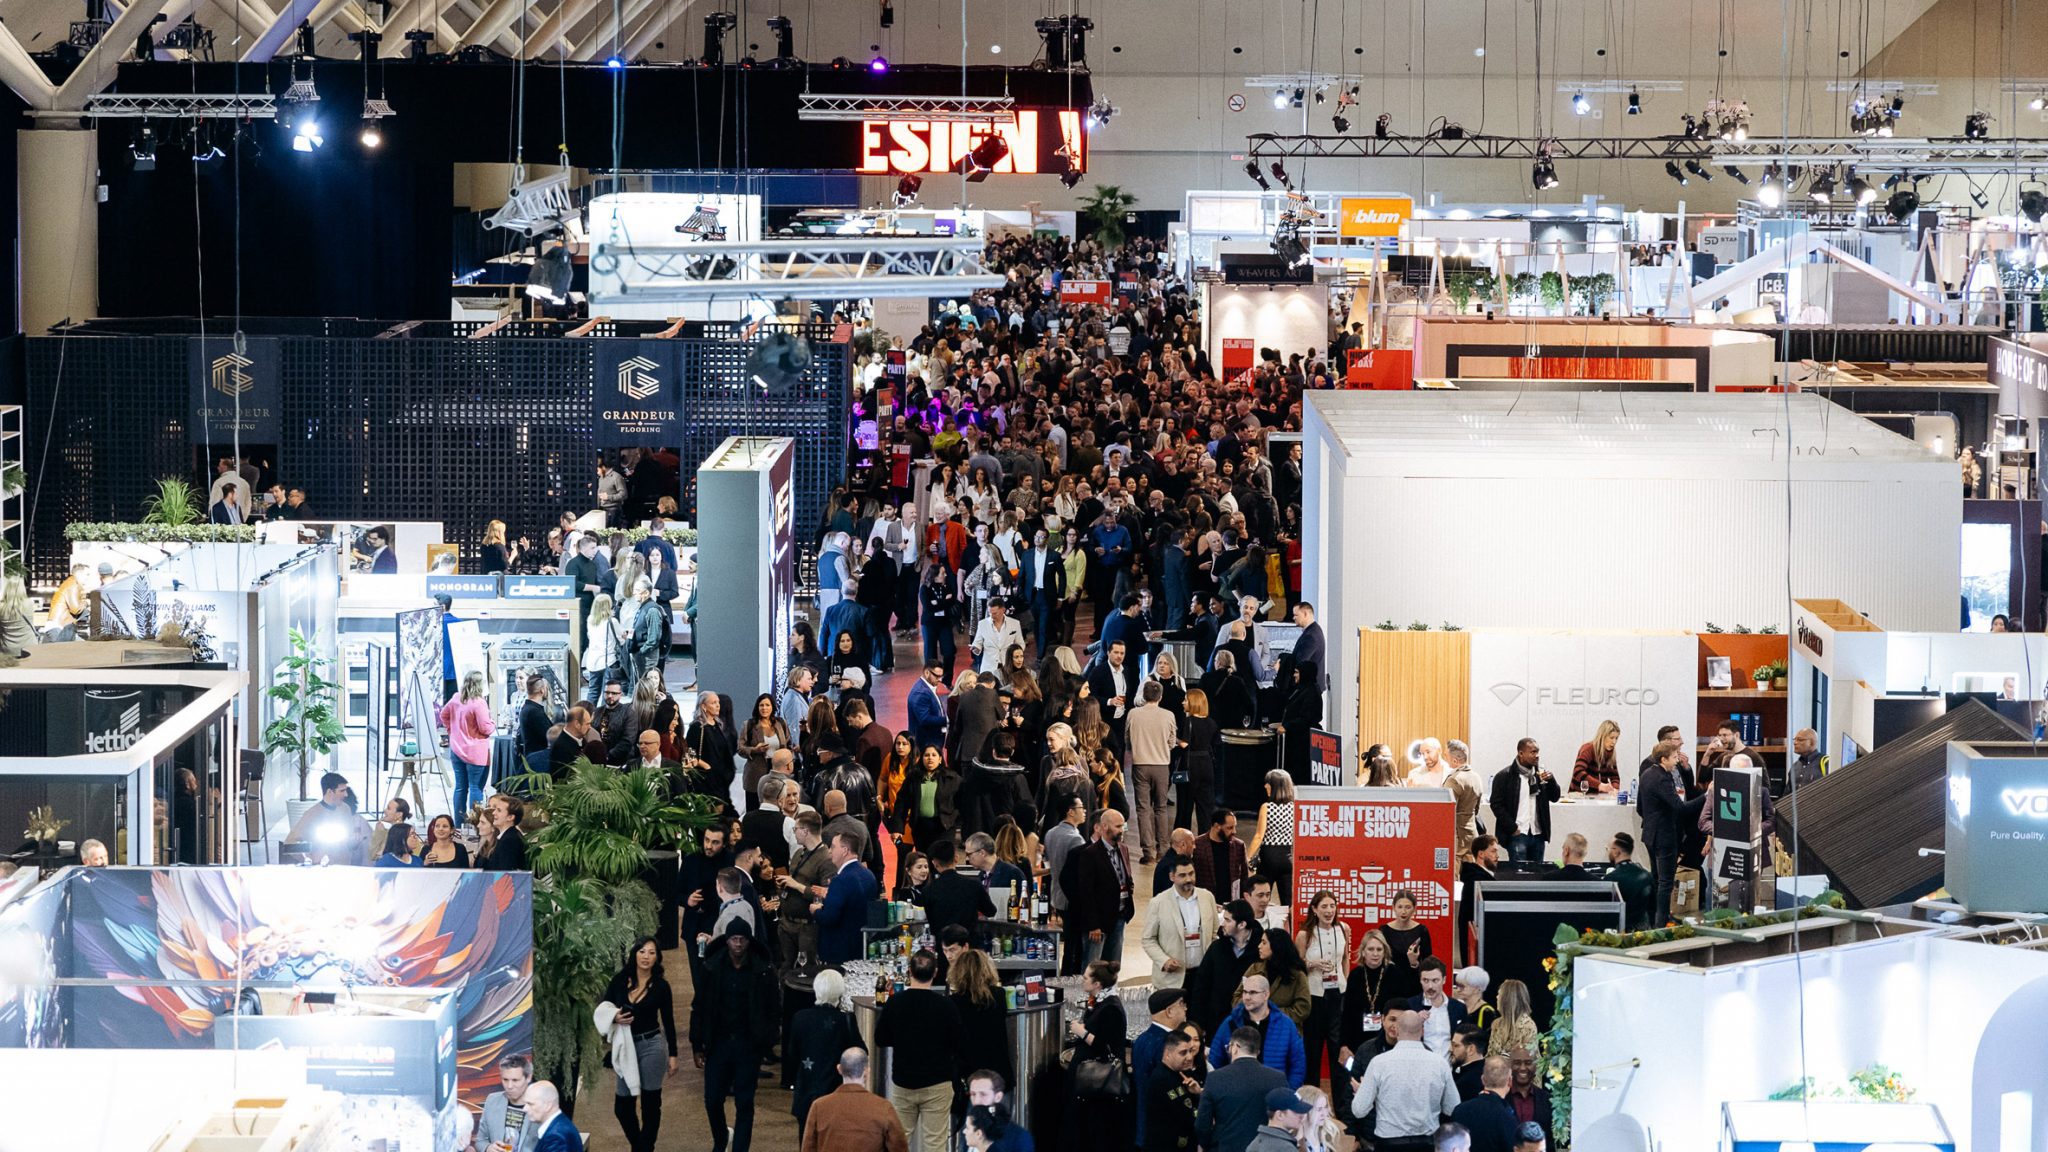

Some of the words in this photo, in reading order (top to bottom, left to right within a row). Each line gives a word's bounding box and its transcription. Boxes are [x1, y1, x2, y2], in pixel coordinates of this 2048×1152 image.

[1354, 209, 1400, 224] blum
[1237, 268, 1281, 277] WEAVERS
[1284, 269, 1302, 278] ART
[1119, 281, 1138, 290] PARTY
[887, 363, 905, 374] PARTY
[1357, 359, 1374, 368] DAY
[1996, 347, 2022, 382] HOUSE
[2023, 356, 2035, 384] OF
[602, 410, 676, 420] GRANDEUR
[878, 404, 892, 416] PARTY
[430, 582, 494, 592] MONOGRAM
[509, 579, 570, 596] dacor
[1536, 686, 1660, 706] FLEURCO
[1311, 760, 1341, 787] PARTY
[1299, 804, 1330, 821] THE
[1338, 805, 1411, 822] INTERIOR
[1298, 821, 1355, 837] DESIGN
[1364, 822, 1411, 838] SHOW
[1990, 830, 2011, 840] Pure
[2012, 831, 2046, 841] Quality.
